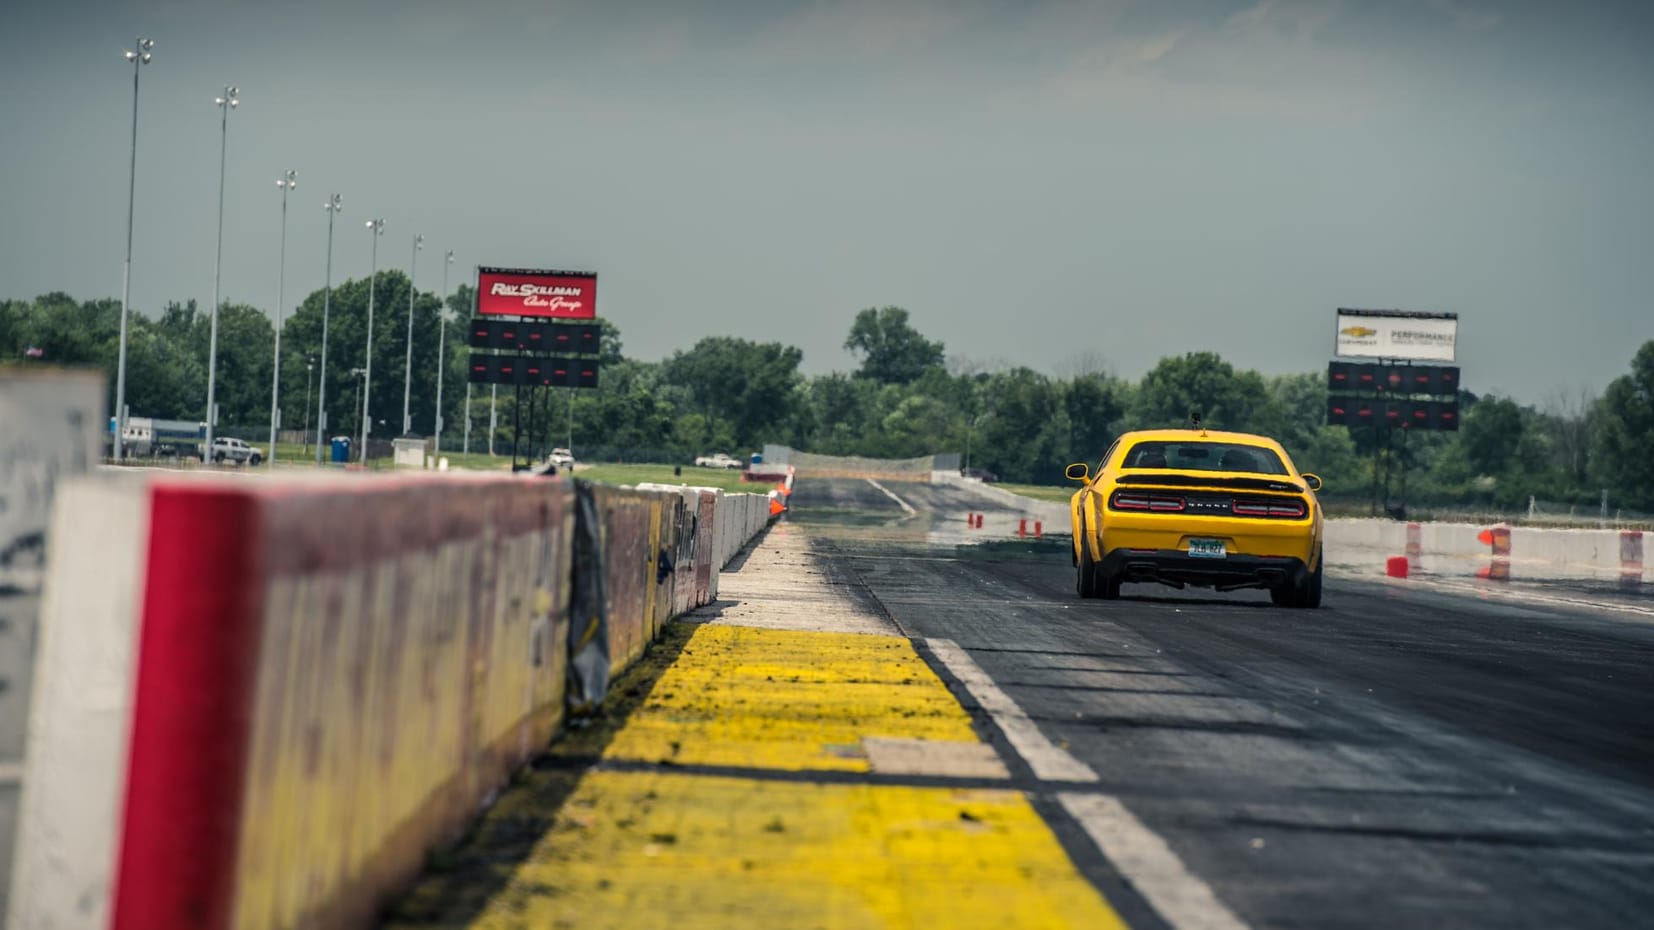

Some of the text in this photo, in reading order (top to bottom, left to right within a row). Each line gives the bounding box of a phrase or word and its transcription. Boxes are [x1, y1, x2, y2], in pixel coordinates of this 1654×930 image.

[491, 283, 581, 296] RAY SKILLMAN
[523, 295, 582, 311] Auto Group
